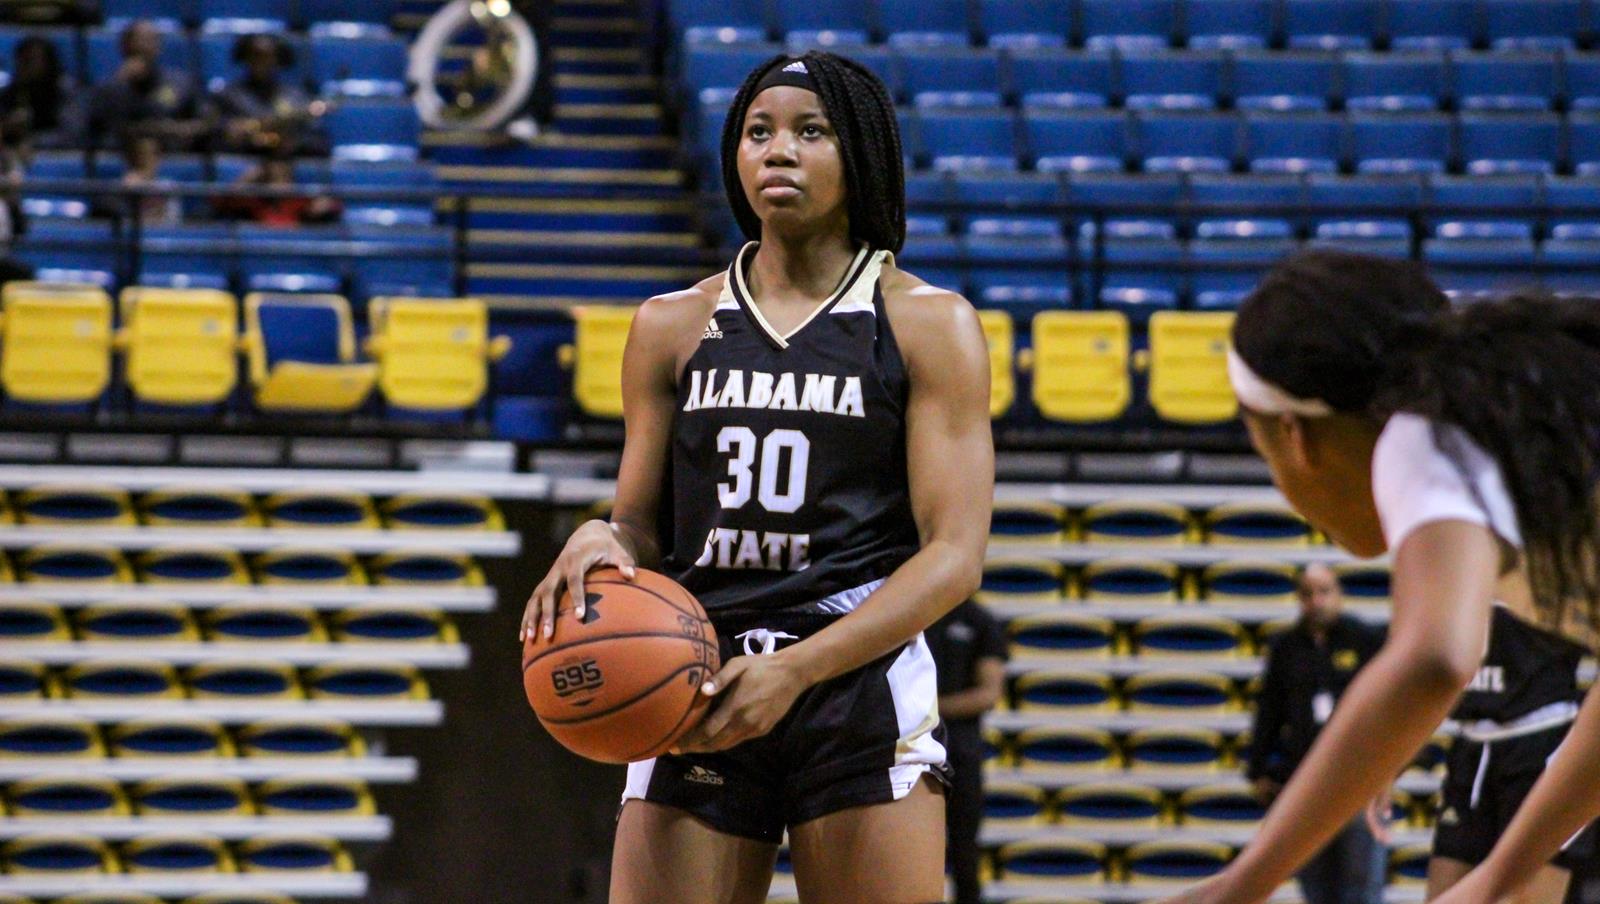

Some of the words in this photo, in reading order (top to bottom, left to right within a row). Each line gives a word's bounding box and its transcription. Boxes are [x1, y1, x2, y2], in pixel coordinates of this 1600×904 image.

[683, 369, 865, 417] ALABAMA
[717, 426, 810, 513] 30
[551, 660, 601, 690] 695
